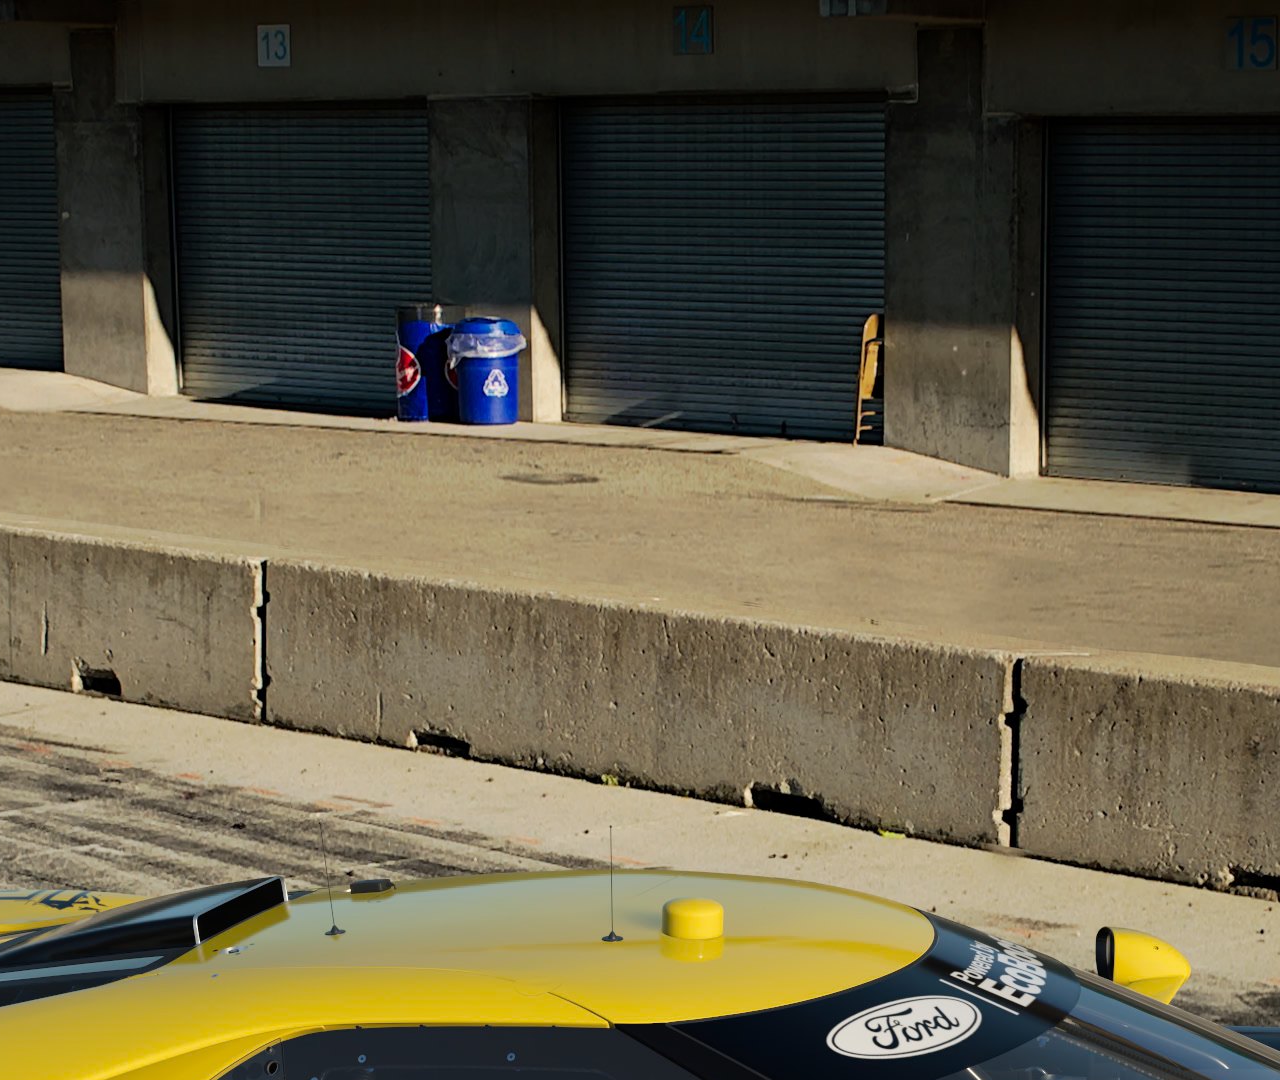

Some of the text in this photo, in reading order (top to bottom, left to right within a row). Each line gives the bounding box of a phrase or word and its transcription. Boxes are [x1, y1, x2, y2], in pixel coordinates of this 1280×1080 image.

[261, 30, 287, 60] 13
[674, 8, 709, 54] 14
[1229, 19, 1274, 68] 15
[864, 1006, 960, 1050] Ford
